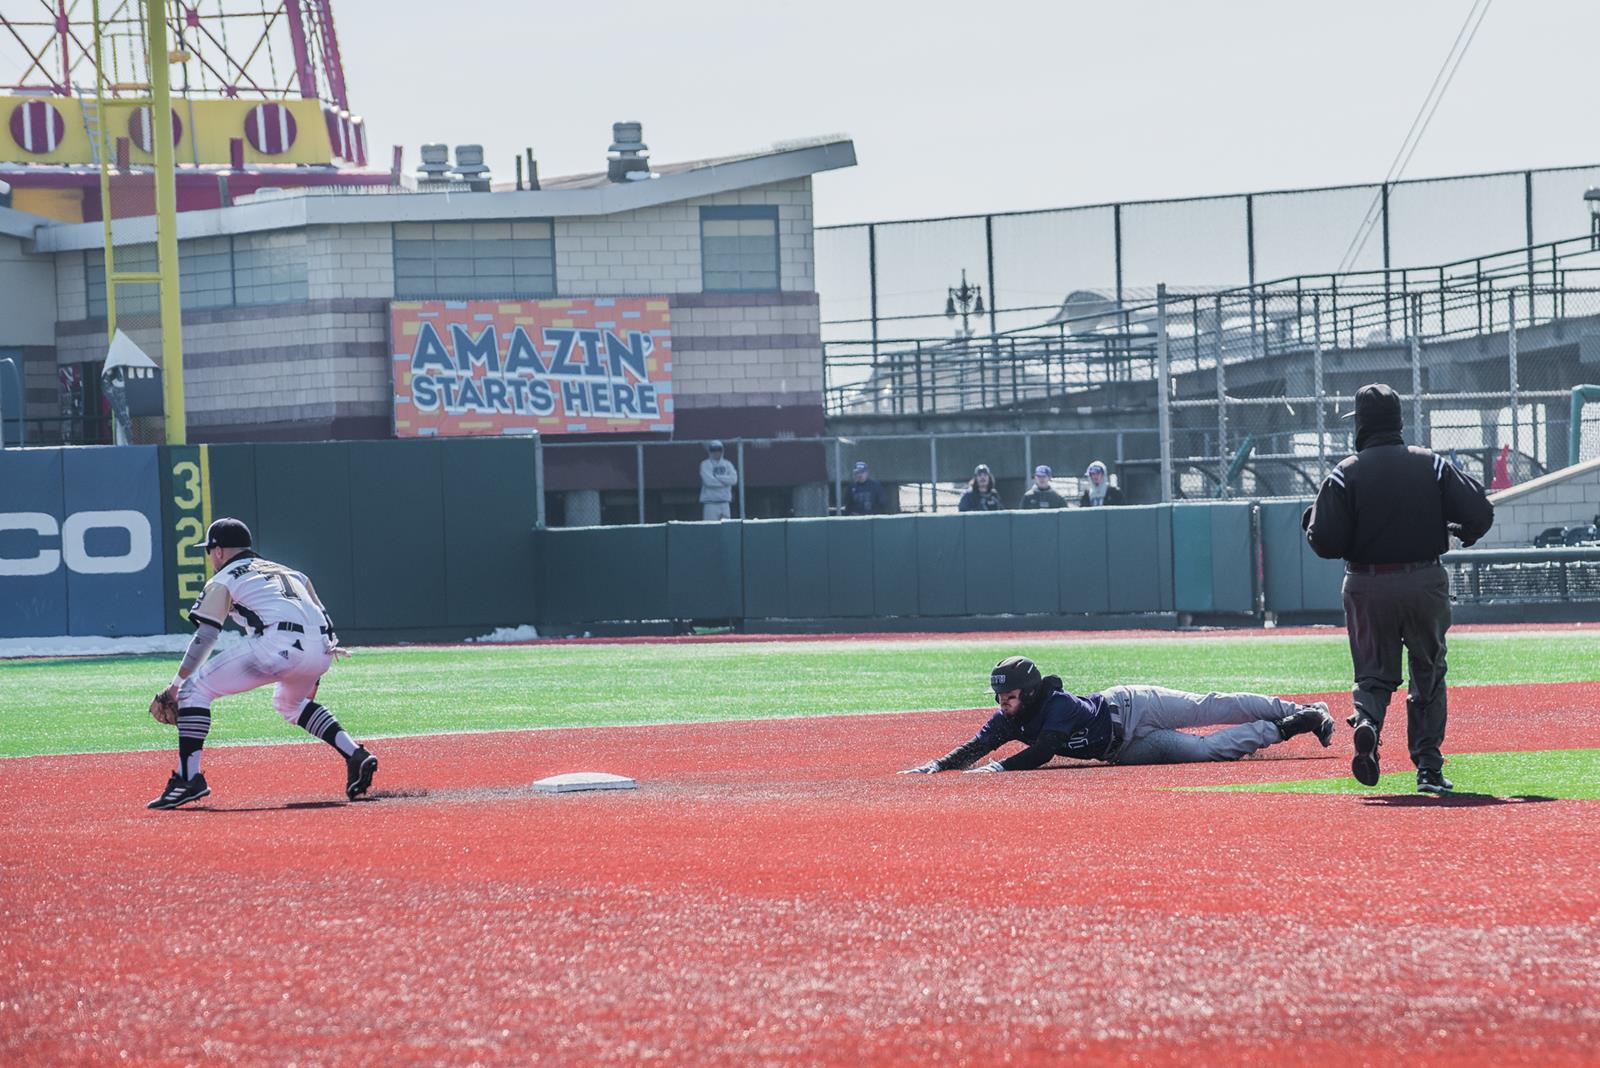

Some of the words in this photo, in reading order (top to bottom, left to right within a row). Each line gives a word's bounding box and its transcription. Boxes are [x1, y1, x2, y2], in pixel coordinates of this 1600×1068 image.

[411, 321, 655, 383] AMAZIN'
[412, 374, 555, 416] STARTS
[560, 380, 661, 419] HERE
[0, 509, 152, 576] CO
